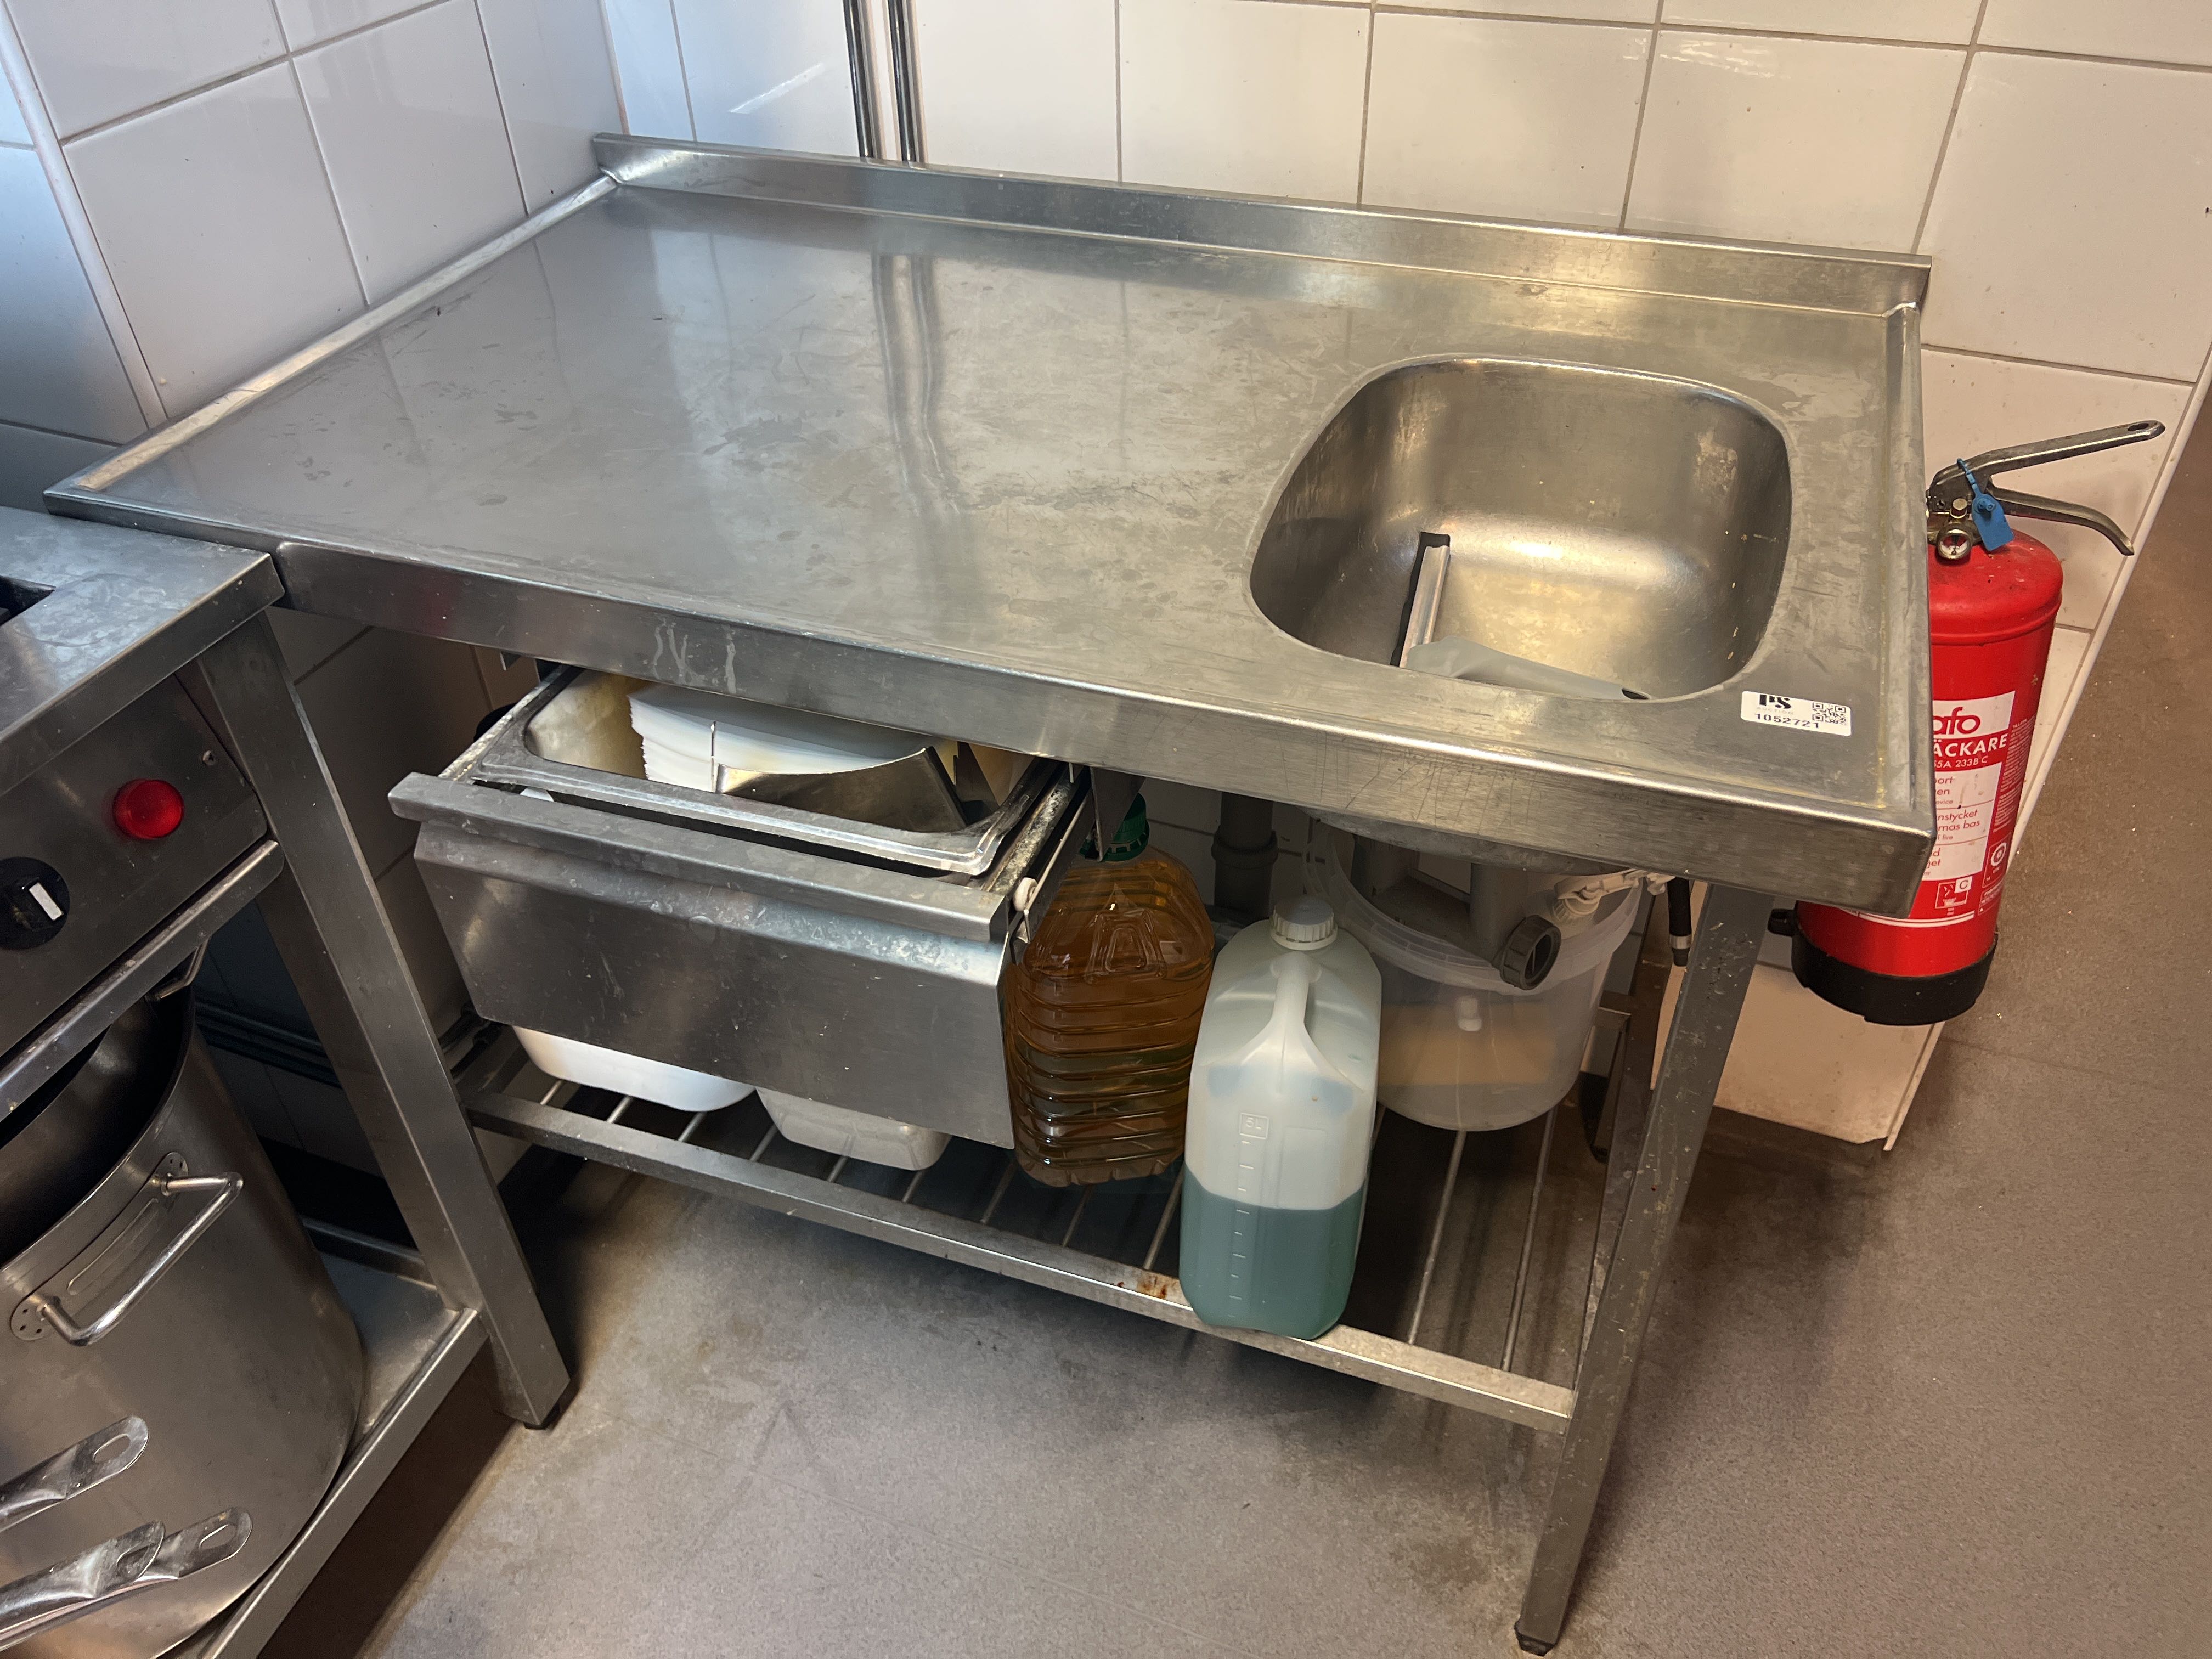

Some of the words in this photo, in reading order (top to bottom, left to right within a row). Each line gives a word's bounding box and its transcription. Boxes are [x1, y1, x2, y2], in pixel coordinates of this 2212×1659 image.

[1756, 707, 1793, 715] AUCTION
[1754, 713, 1819, 729] 1052721
[1933, 733, 2008, 757] ÄCKARE
[1963, 820, 1980, 829] bas
[1246, 1117, 1262, 1130] 5L
